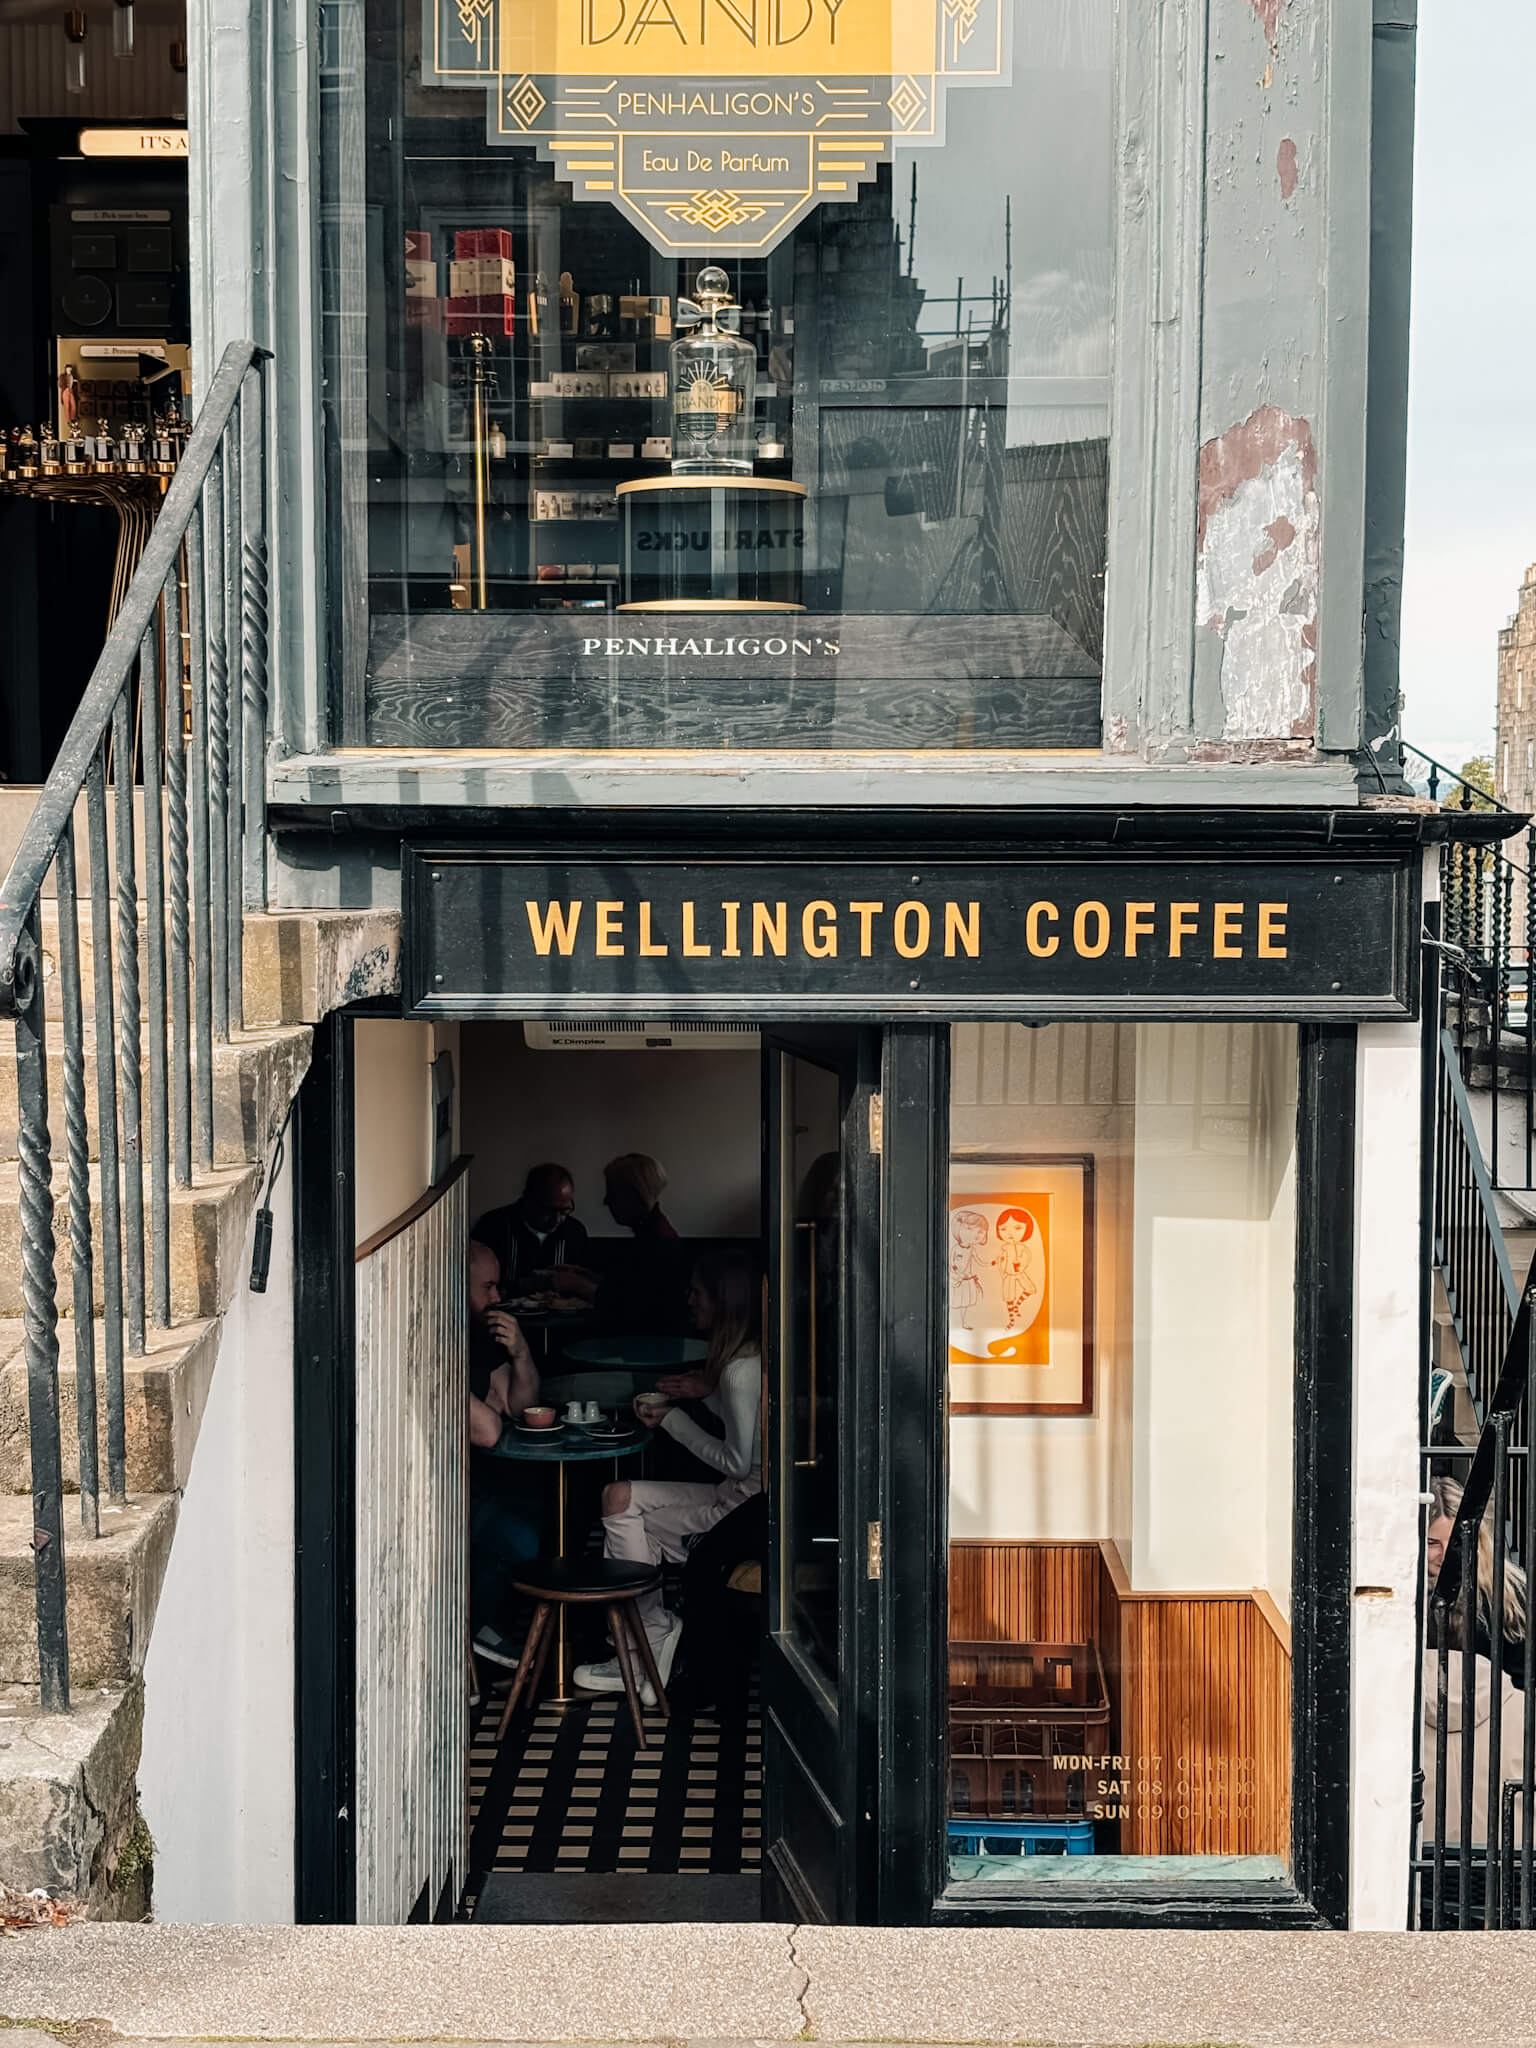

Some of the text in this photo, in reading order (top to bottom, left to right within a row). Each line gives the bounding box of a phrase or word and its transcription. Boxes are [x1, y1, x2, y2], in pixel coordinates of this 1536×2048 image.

[581, 0, 844, 47] DANDY
[617, 91, 816, 117] PENHALIGON'S
[140, 135, 172, 149] IT'S
[642, 150, 790, 173] Eau De Parfum
[682, 396, 726, 409] DANDY
[583, 638, 841, 656] PENHALIGON'S
[525, 900, 1289, 960] WELLINGTON COFFEE
[1053, 1755, 1131, 1770] MON-FRI
[1097, 1780, 1131, 1795] SAT
[1094, 1805, 1131, 1819] SUN
